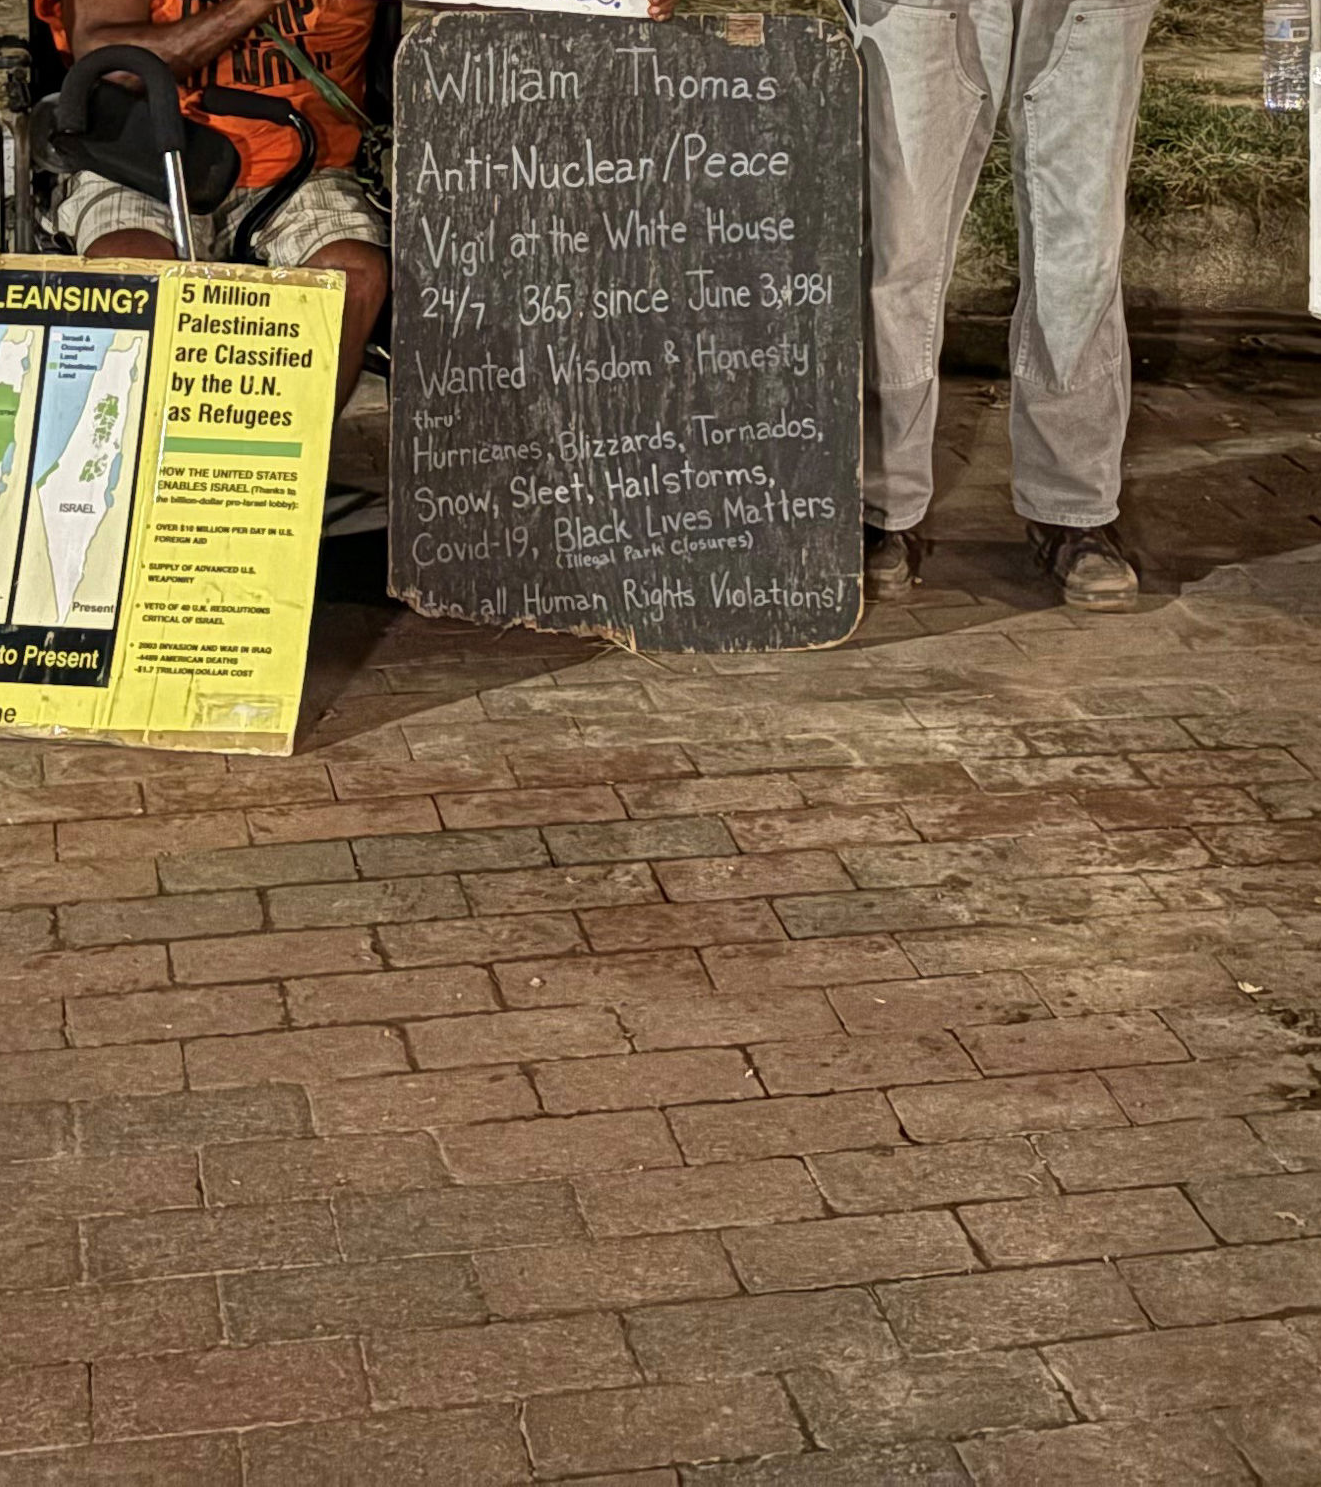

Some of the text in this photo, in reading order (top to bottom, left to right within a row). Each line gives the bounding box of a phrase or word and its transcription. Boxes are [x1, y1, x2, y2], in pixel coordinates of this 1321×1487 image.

[423, 47, 778, 107] William Thomas
[420, 207, 795, 277] Vigil at the White House
[182, 283, 270, 307] 5 Million
[178, 313, 300, 338] Palestinians
[175, 344, 313, 368] are Classified
[171, 372, 282, 397] by the U.N.
[168, 404, 293, 429] as Refugees
[159, 466, 298, 482] HOW THE UNITED STATES
[59, 503, 96, 514] ISRAEL
[412, 490, 836, 567] Covid-19, Black Lives Matters
[72, 602, 114, 614] Present
[23, 644, 98, 669] Present
